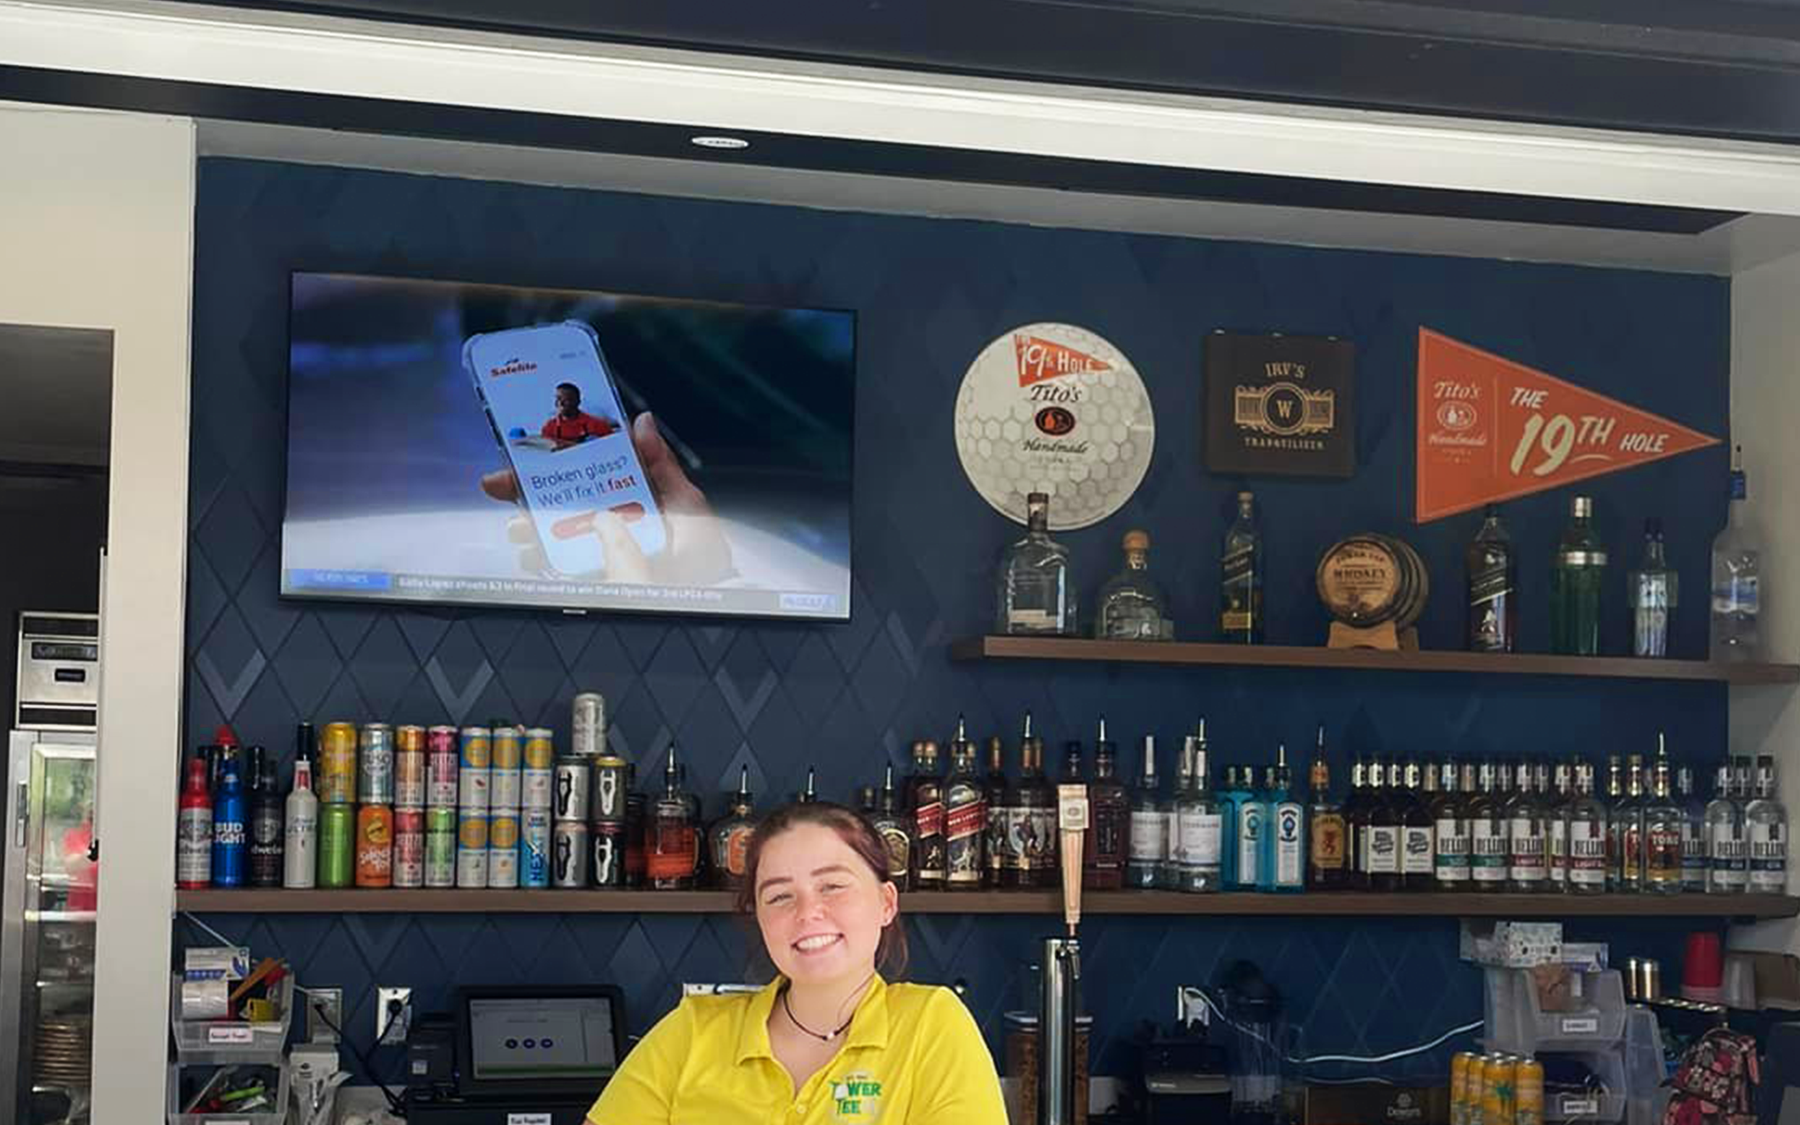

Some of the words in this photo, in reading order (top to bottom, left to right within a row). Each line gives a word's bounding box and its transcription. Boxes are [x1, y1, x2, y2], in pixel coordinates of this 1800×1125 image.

[1264, 361, 1306, 379] IRV'S
[1030, 384, 1083, 403] Tito's
[1434, 381, 1483, 400] Tito's
[1510, 387, 1549, 410] THE
[1276, 400, 1293, 419] W
[1619, 433, 1670, 453] HOLE
[530, 468, 584, 491] Broken
[584, 455, 629, 481] glass?
[606, 474, 638, 493] fast
